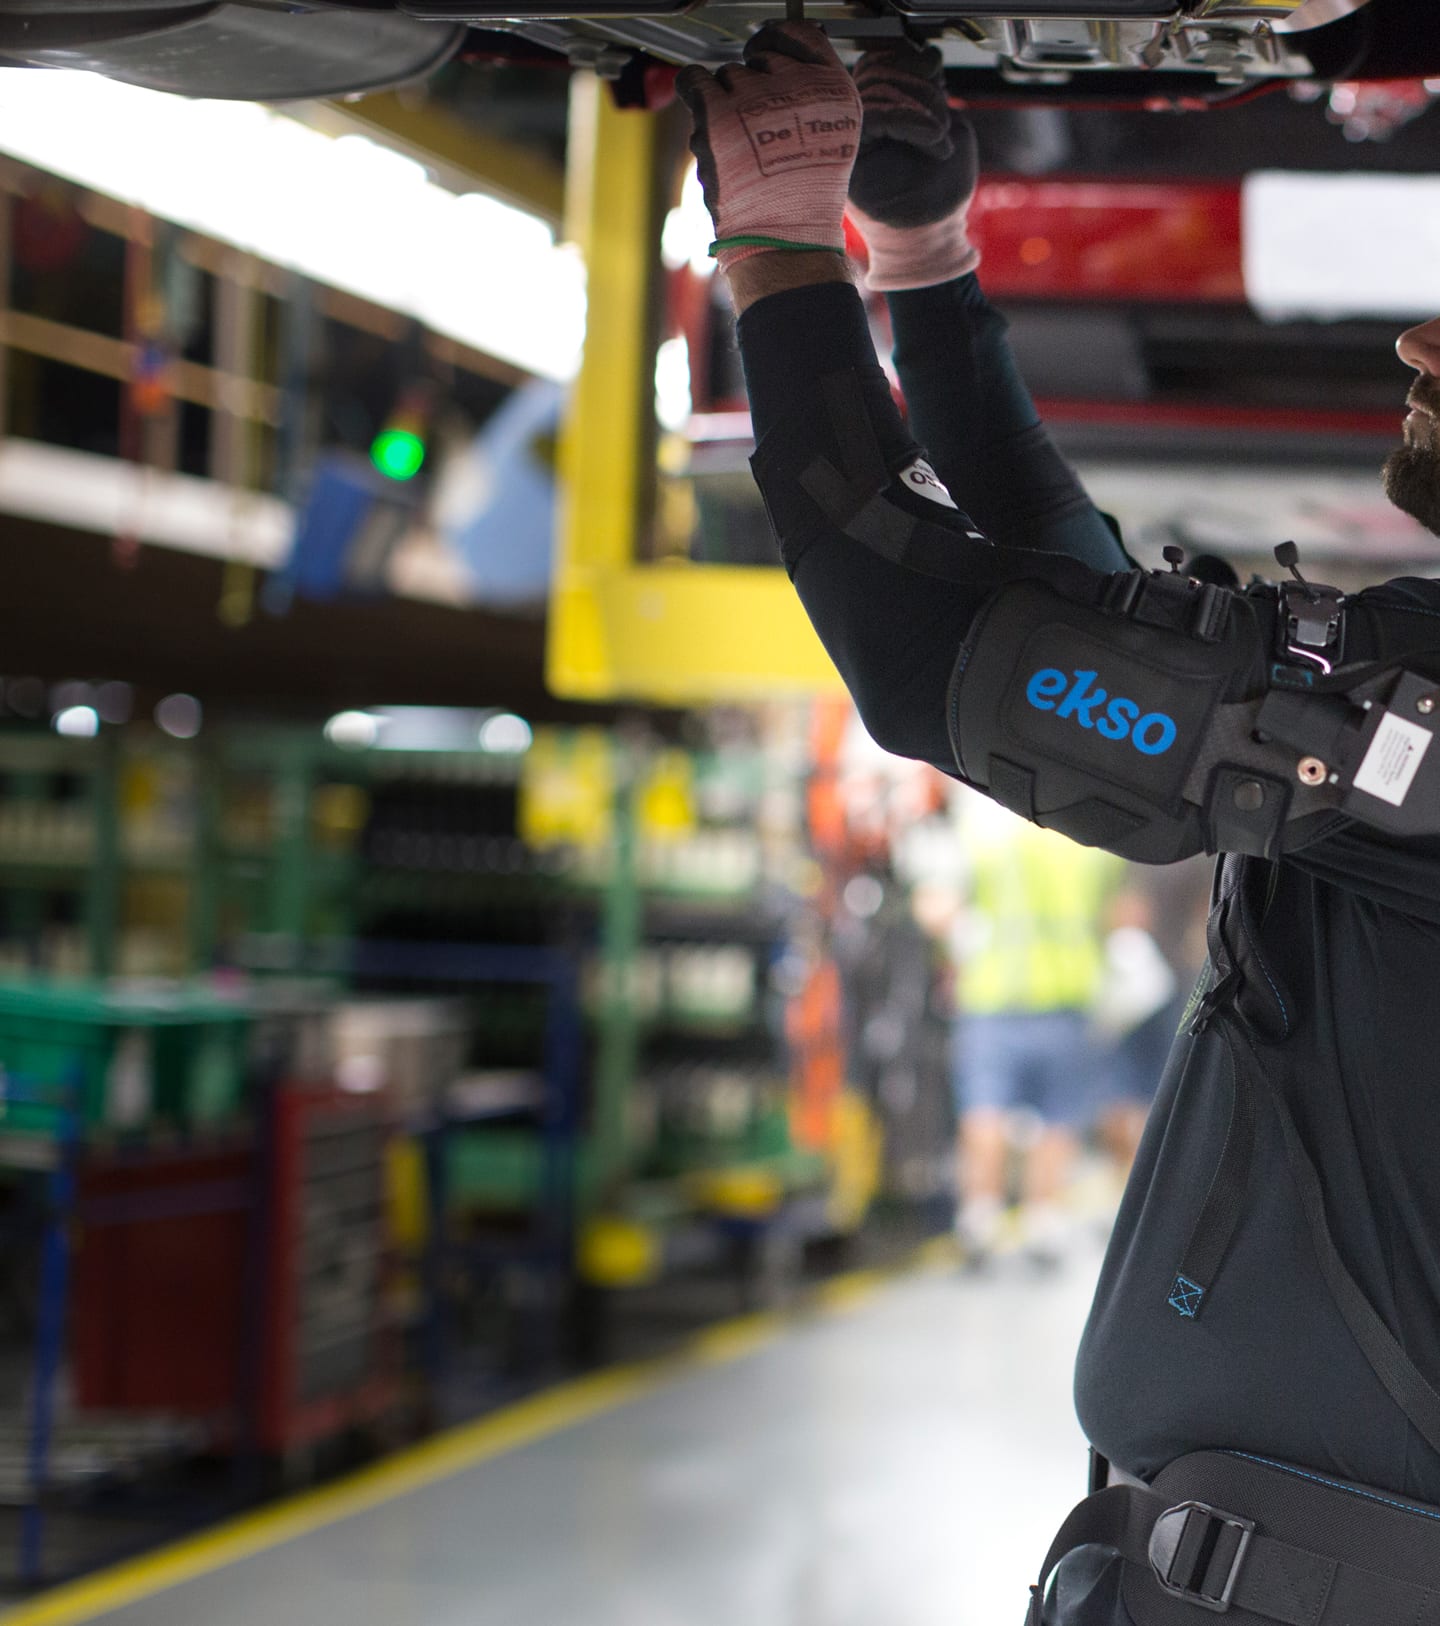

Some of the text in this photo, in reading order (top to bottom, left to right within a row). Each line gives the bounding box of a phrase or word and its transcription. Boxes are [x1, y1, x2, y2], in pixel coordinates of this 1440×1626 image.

[756, 115, 857, 145] De Tach
[1026, 668, 1177, 756] ekso
